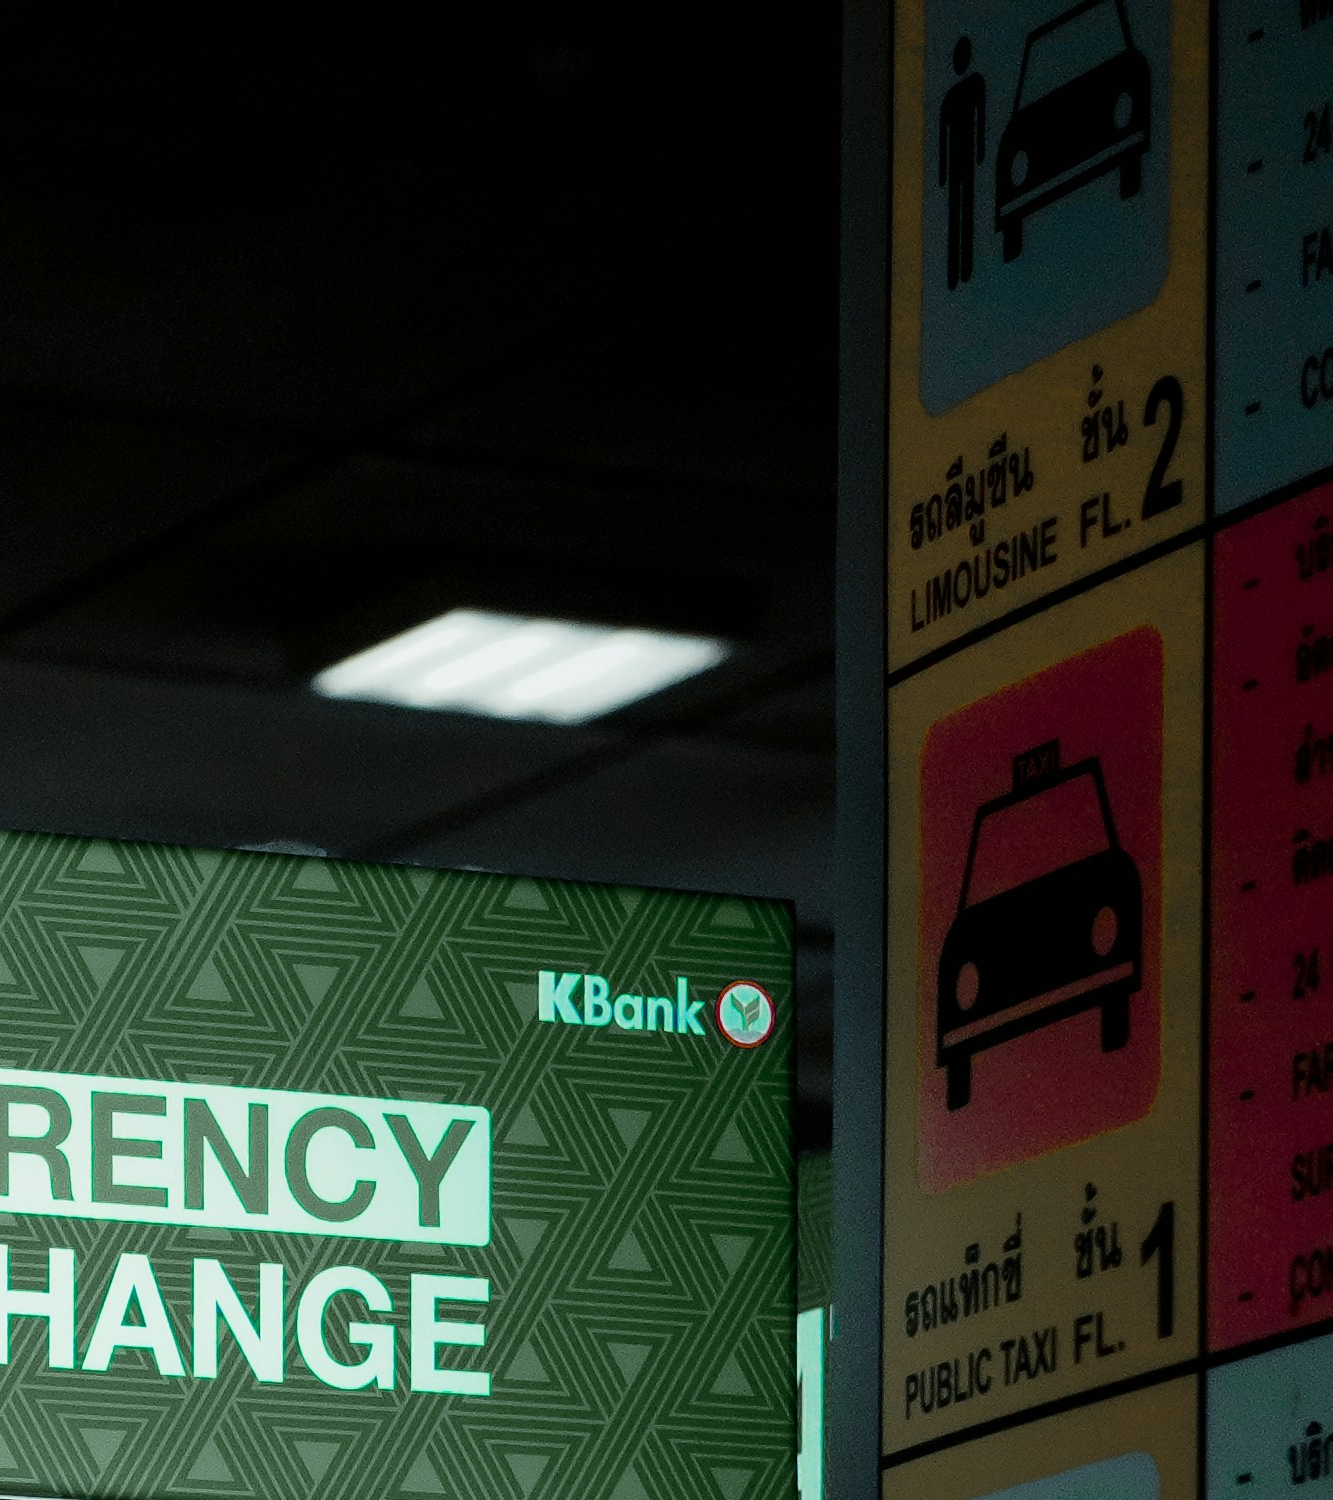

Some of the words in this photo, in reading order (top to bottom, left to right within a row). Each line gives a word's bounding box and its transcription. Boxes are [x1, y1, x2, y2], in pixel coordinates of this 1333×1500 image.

[1141, 375, 1183, 521] 2
[911, 517, 1057, 632] LIMOUSINE
[1081, 493, 1130, 548] FL.
[538, 970, 705, 1036] KBank
[1141, 1202, 1174, 1339] 1
[905, 1348, 991, 1420] PUBLIC
[1001, 1326, 1056, 1385] TAXI
[1074, 1312, 1124, 1364] FL.
